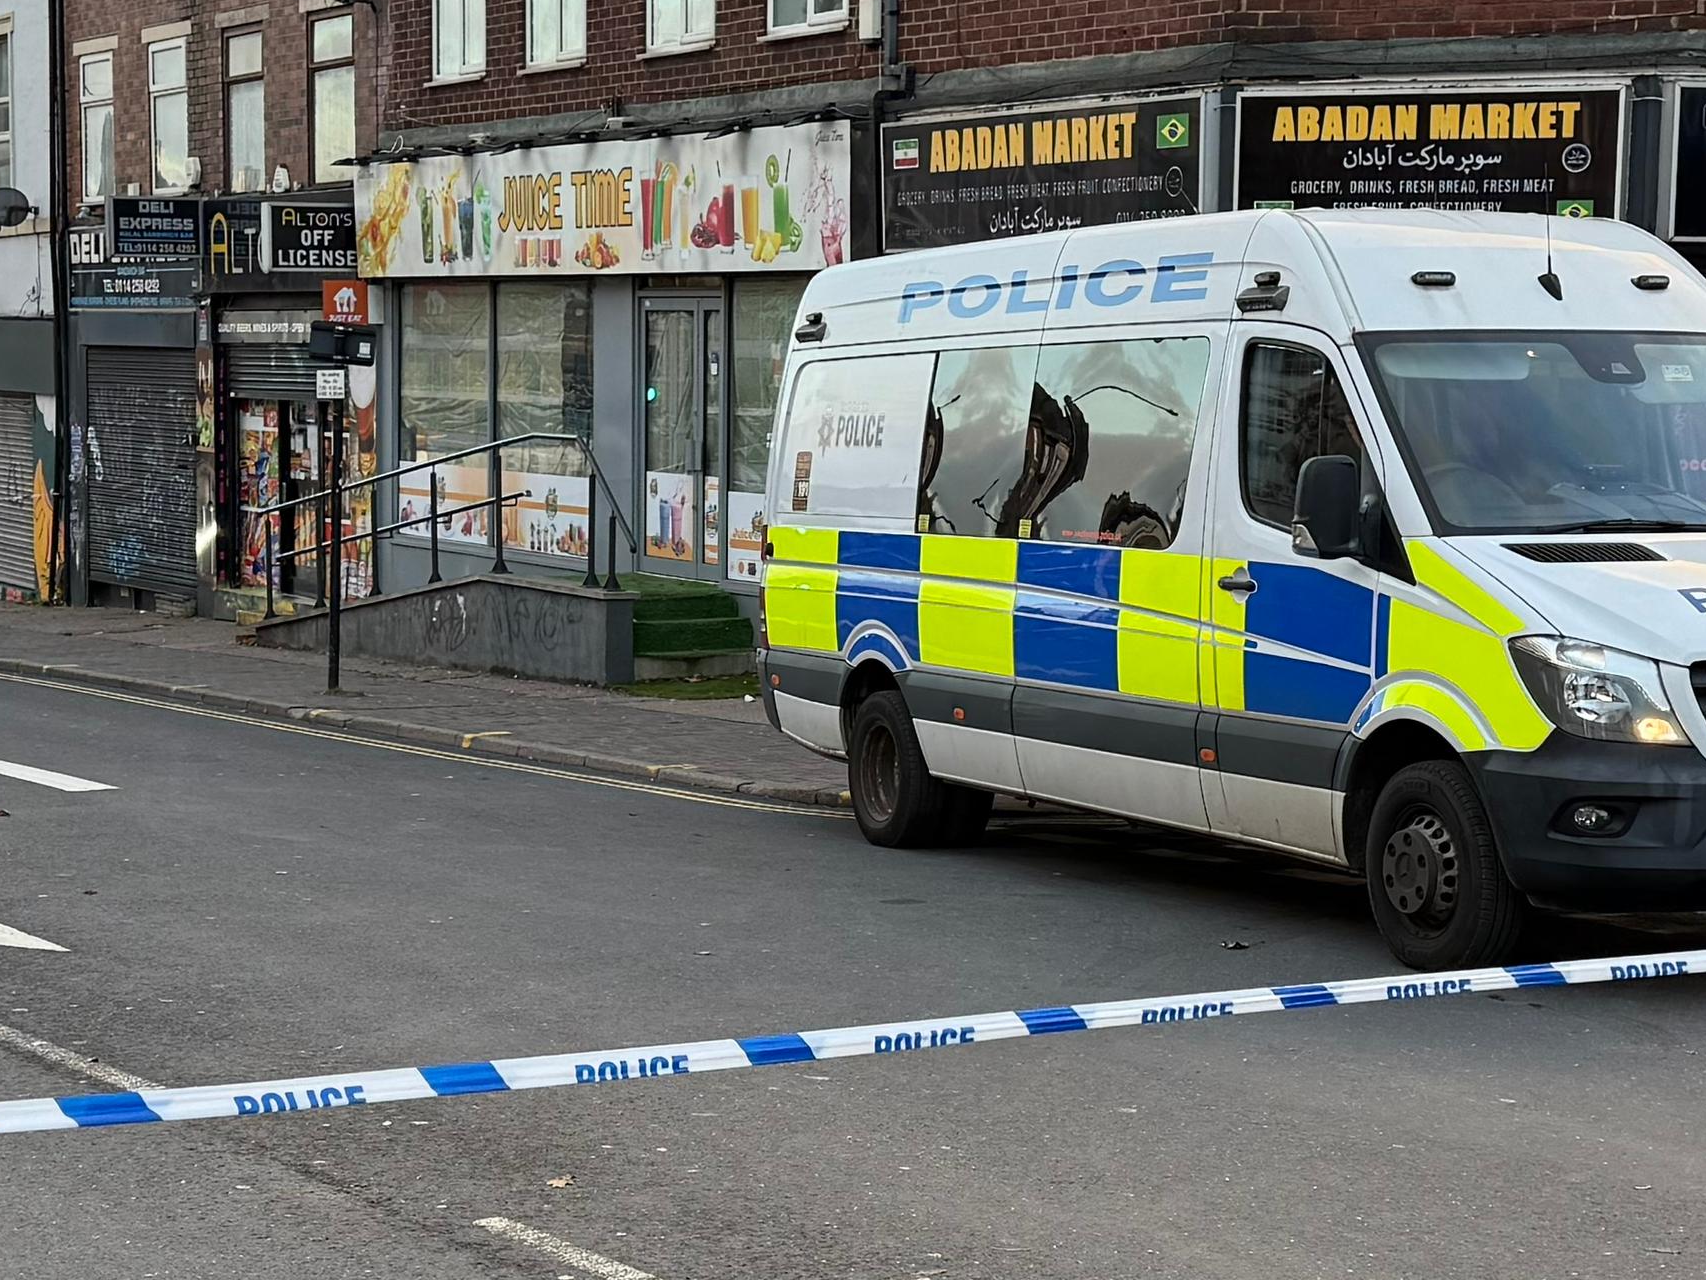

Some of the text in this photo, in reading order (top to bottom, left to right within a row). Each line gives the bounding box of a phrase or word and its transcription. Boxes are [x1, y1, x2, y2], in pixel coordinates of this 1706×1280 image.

[1272, 102, 1581, 141] ABADAN MARKET
[930, 112, 1136, 173] ABADAN MARKET
[1343, 144, 1502, 175] سوپر مارکت آبادان
[497, 167, 633, 232] JUICE TIME
[1290, 180, 1343, 195] GROCERY,
[1399, 180, 1435, 194] FRESH
[1439, 179, 1479, 195] BREAD,
[1483, 179, 1519, 193] FRESH
[1523, 178, 1555, 193] MEAT
[139, 201, 174, 213] DELI
[989, 207, 1020, 234] آبادان
[119, 217, 194, 230] EXPRESS
[300, 230, 334, 246] OFF
[69, 232, 104, 264] DELI
[278, 250, 357, 266] LICENSE
[897, 252, 1214, 324] POLICE
[835, 413, 885, 448] POLICE
[575, 1054, 690, 1084] POLICE
